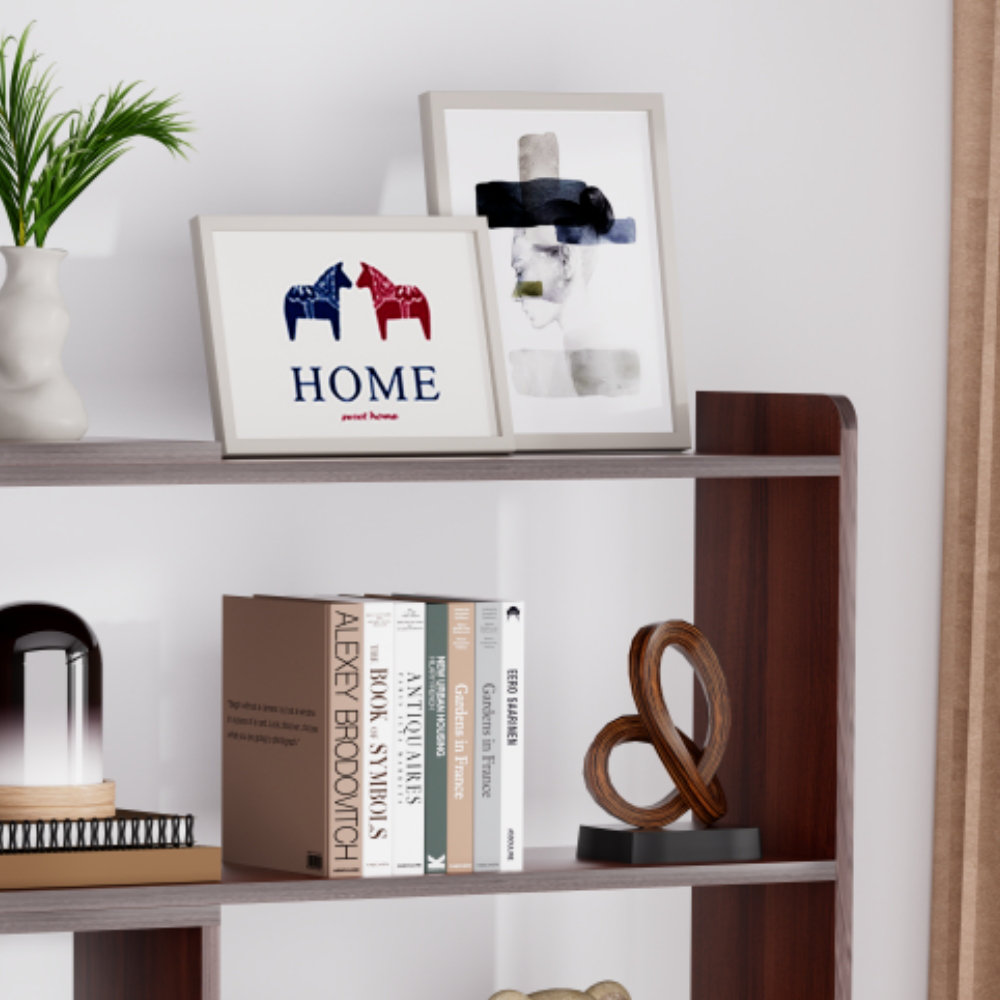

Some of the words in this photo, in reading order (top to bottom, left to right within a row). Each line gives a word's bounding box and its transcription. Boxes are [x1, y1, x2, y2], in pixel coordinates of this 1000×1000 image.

[290, 365, 441, 403] HOME
[334, 610, 360, 702] ALEXEY
[436, 656, 446, 677] NEW
[369, 667, 389, 724] BOOK
[507, 669, 518, 694] EERO
[454, 682, 470, 737] Gardens
[481, 682, 497, 737] Gardens
[507, 697, 518, 747] SAARINEN
[403, 671, 423, 805] ANTIQUAIRES
[456, 740, 470, 753] in
[482, 739, 496, 753] in
[334, 709, 360, 861] BRODOVITCH
[369, 743, 389, 840] SYMBOLS
[454, 755, 470, 800] France
[481, 754, 497, 798] France
